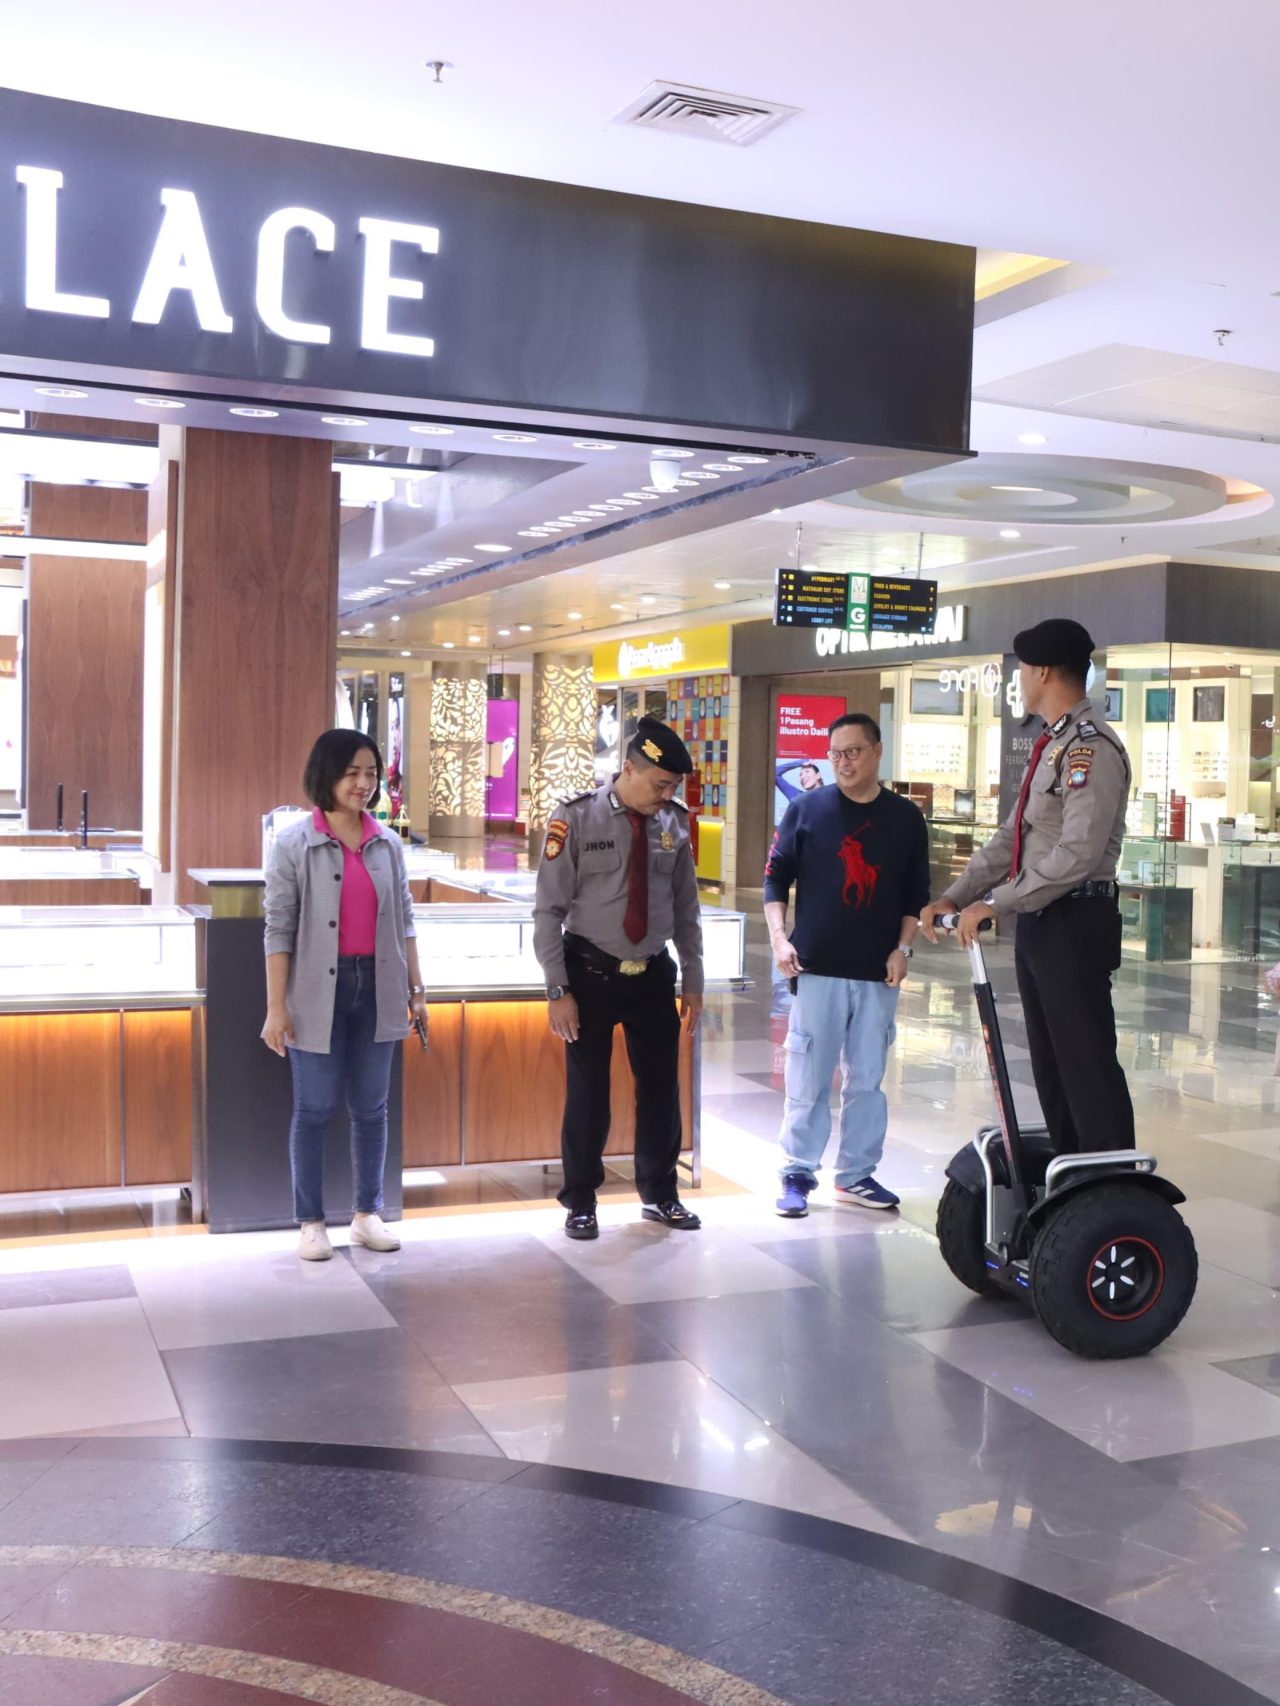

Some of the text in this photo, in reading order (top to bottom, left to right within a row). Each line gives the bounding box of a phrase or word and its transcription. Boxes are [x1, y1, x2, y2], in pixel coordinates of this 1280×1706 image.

[16, 165, 440, 357] LACE
[851, 607, 866, 623] G
[780, 707, 802, 716] FREE
[785, 717, 814, 728] Pasang
[1012, 738, 1033, 750] BOSS
[585, 840, 615, 851] JHON
